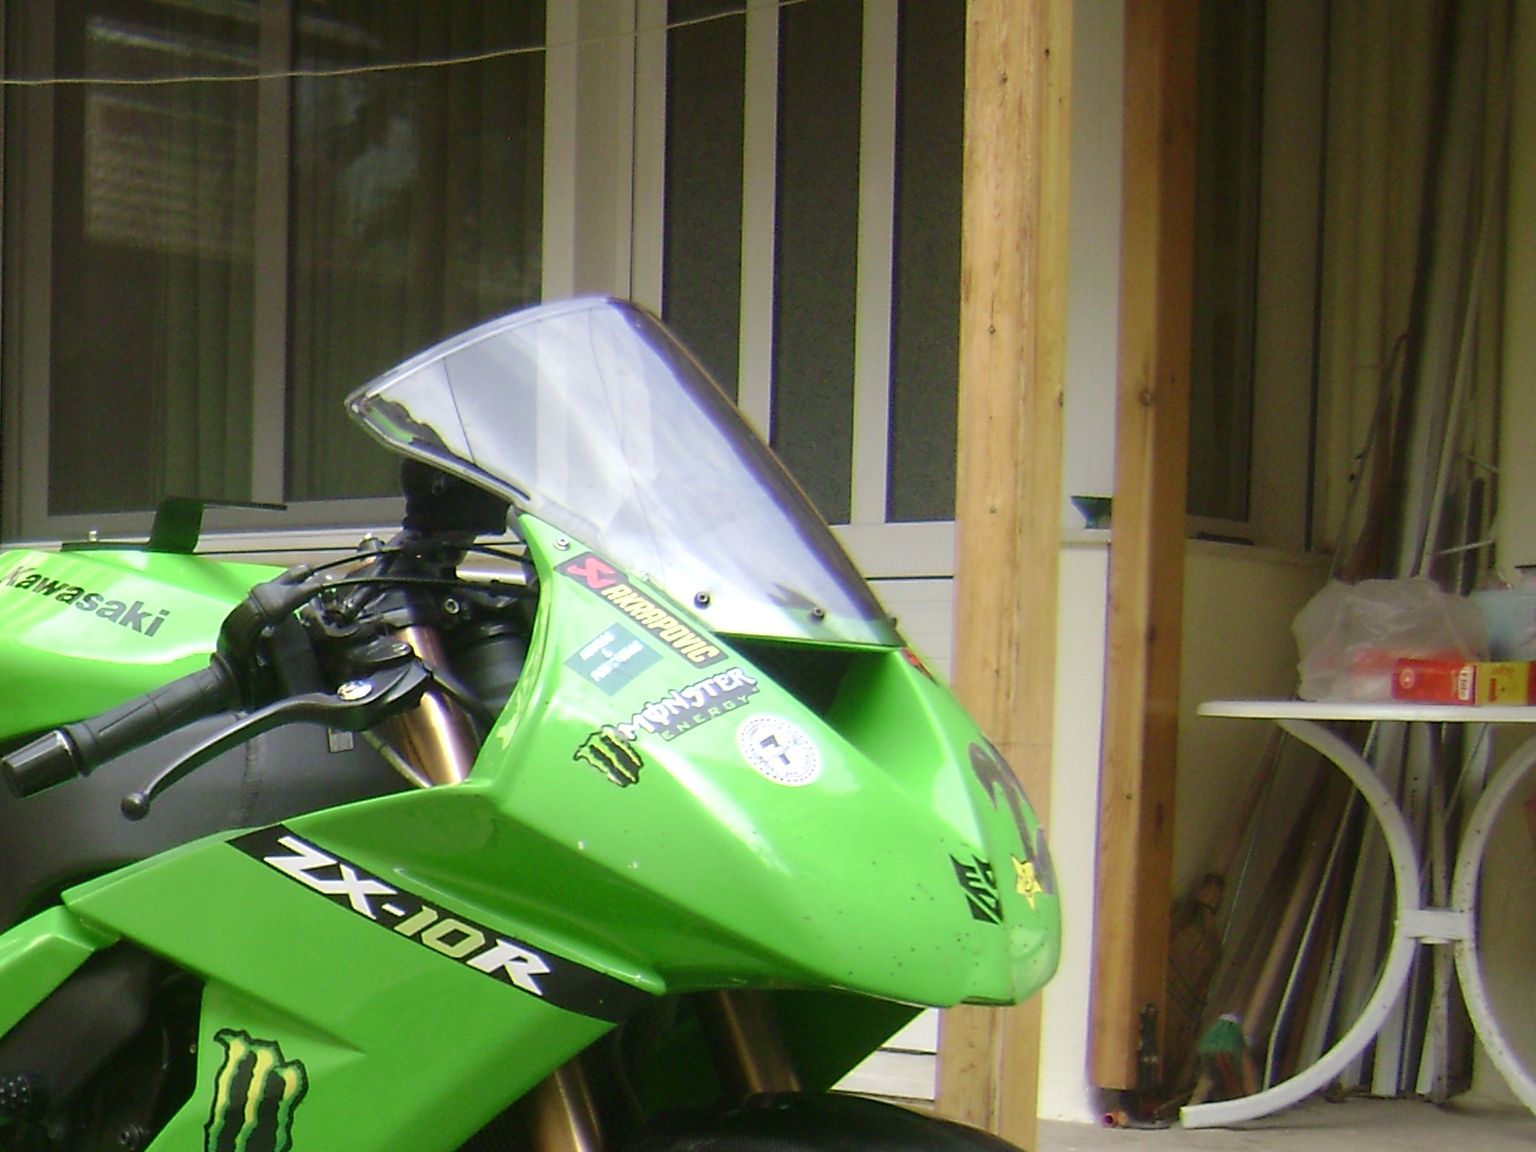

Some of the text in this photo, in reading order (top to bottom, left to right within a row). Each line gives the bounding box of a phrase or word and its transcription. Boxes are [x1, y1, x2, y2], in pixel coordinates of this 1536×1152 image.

[601, 584, 720, 663] AKRAPOVIC
[616, 667, 757, 740] MONSTER
[662, 696, 749, 739] ENERGY
[264, 836, 551, 996] ZX-10R
